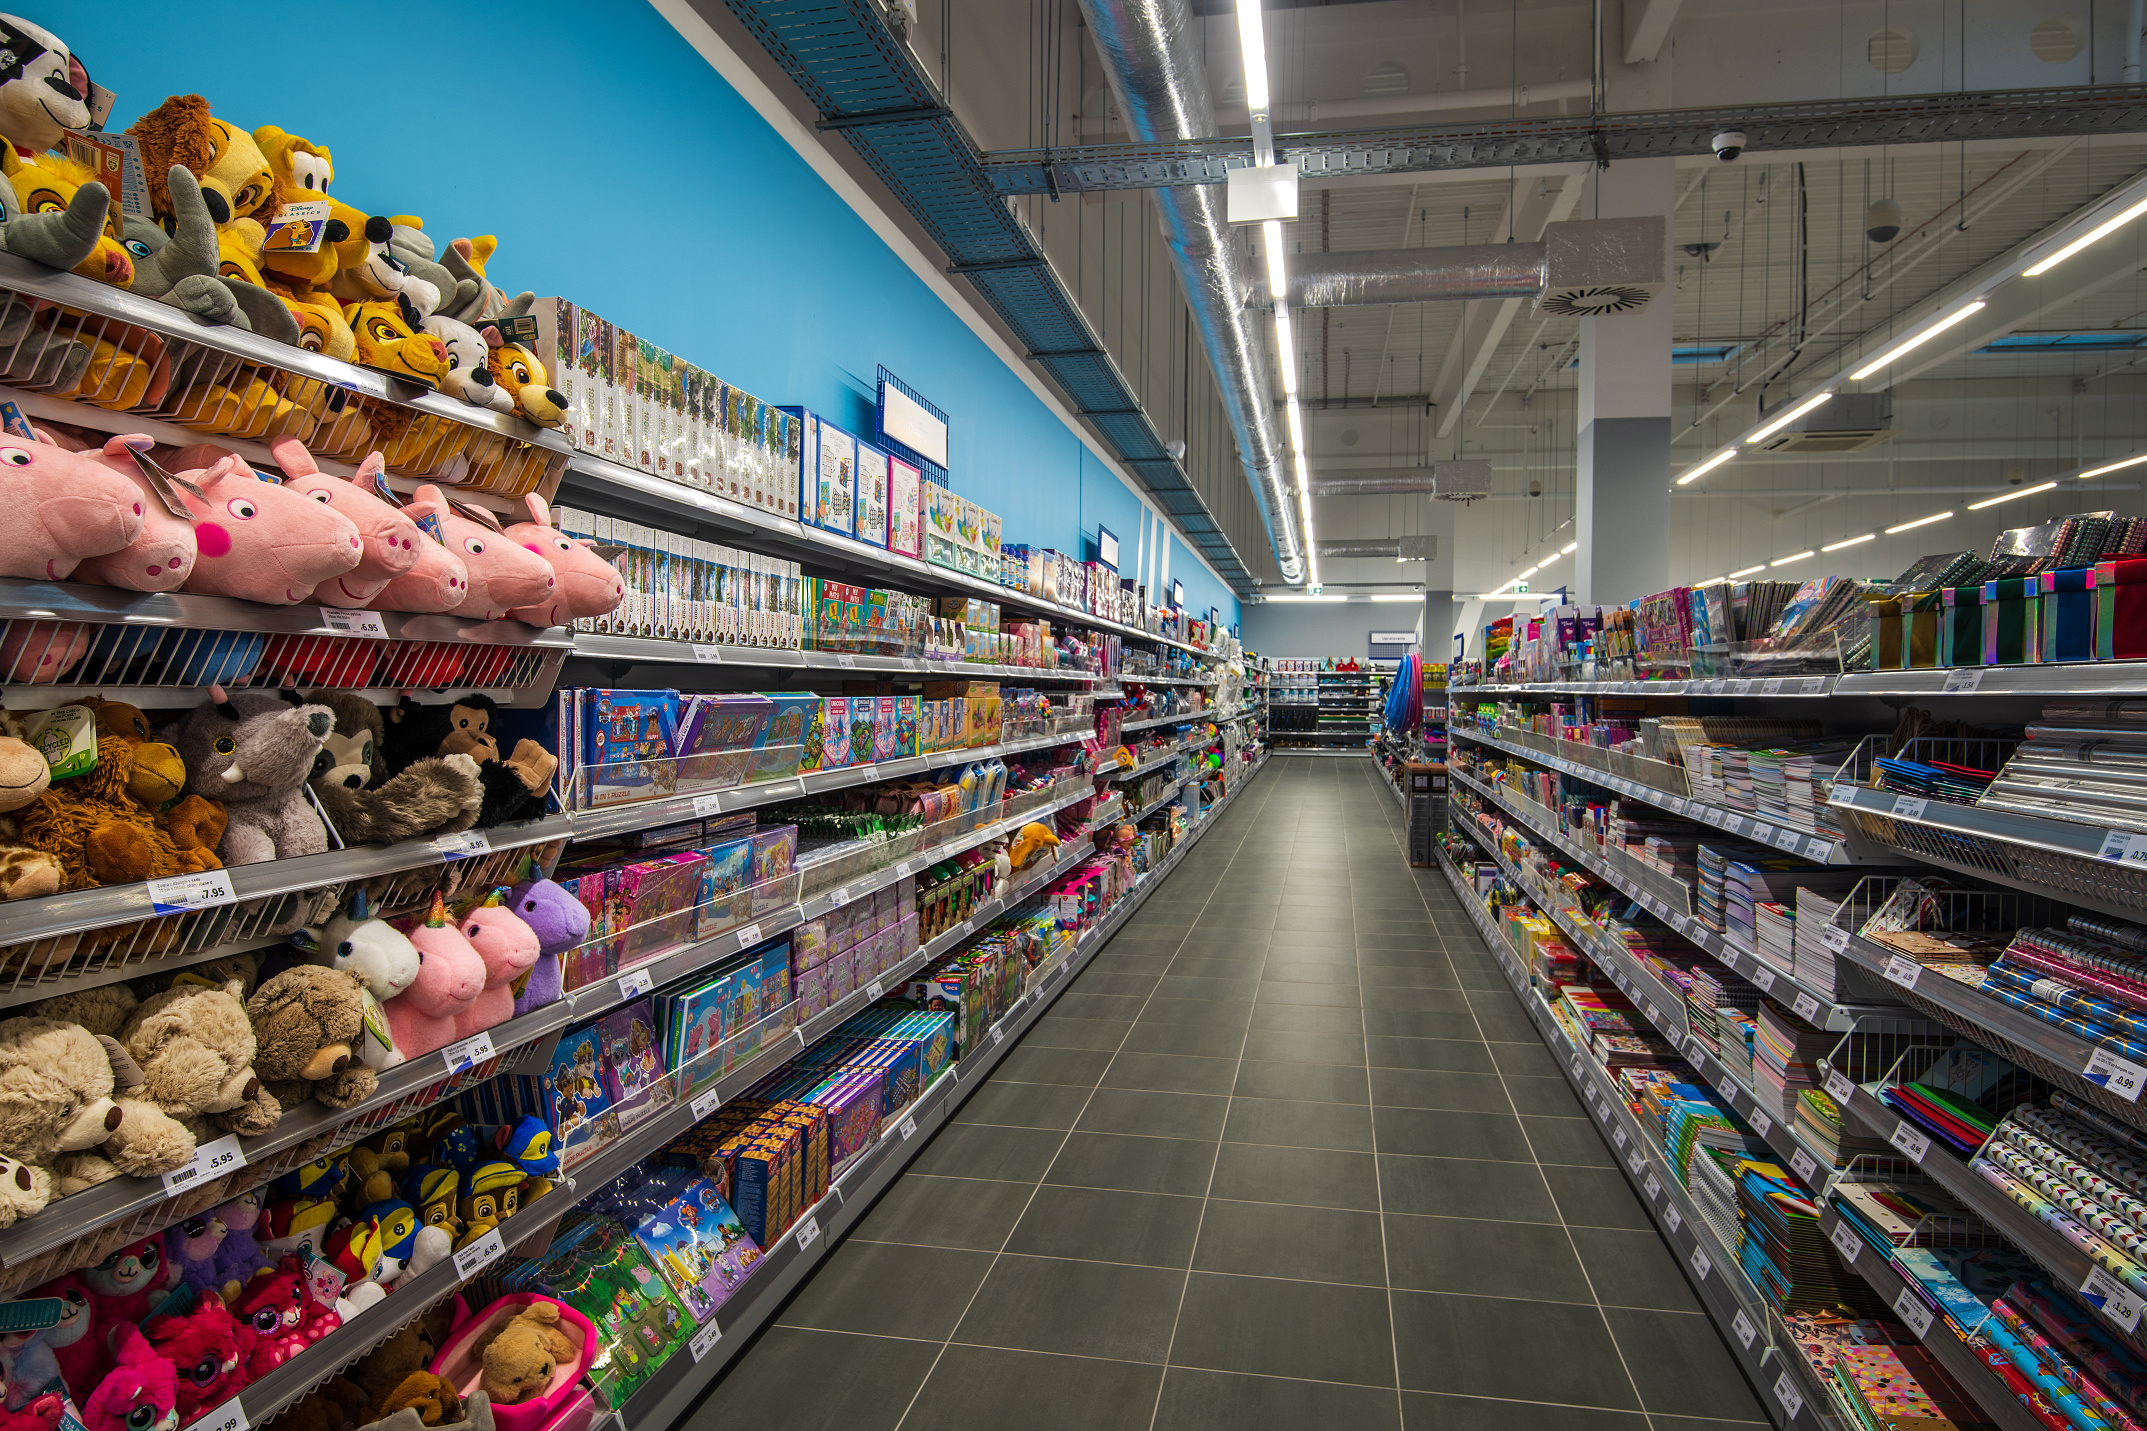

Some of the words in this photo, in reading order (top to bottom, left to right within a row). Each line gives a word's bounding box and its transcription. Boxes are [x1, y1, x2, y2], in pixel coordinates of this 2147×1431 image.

[278, 210, 321, 218] CLASSICS
[611, 790, 631, 800] PUZZLE
[752, 902, 769, 914] PUZZLE
[698, 923, 718, 935] PUZZLE
[636, 1107, 651, 1119] PUZZLE
[575, 1145, 593, 1159] PUZZLE
